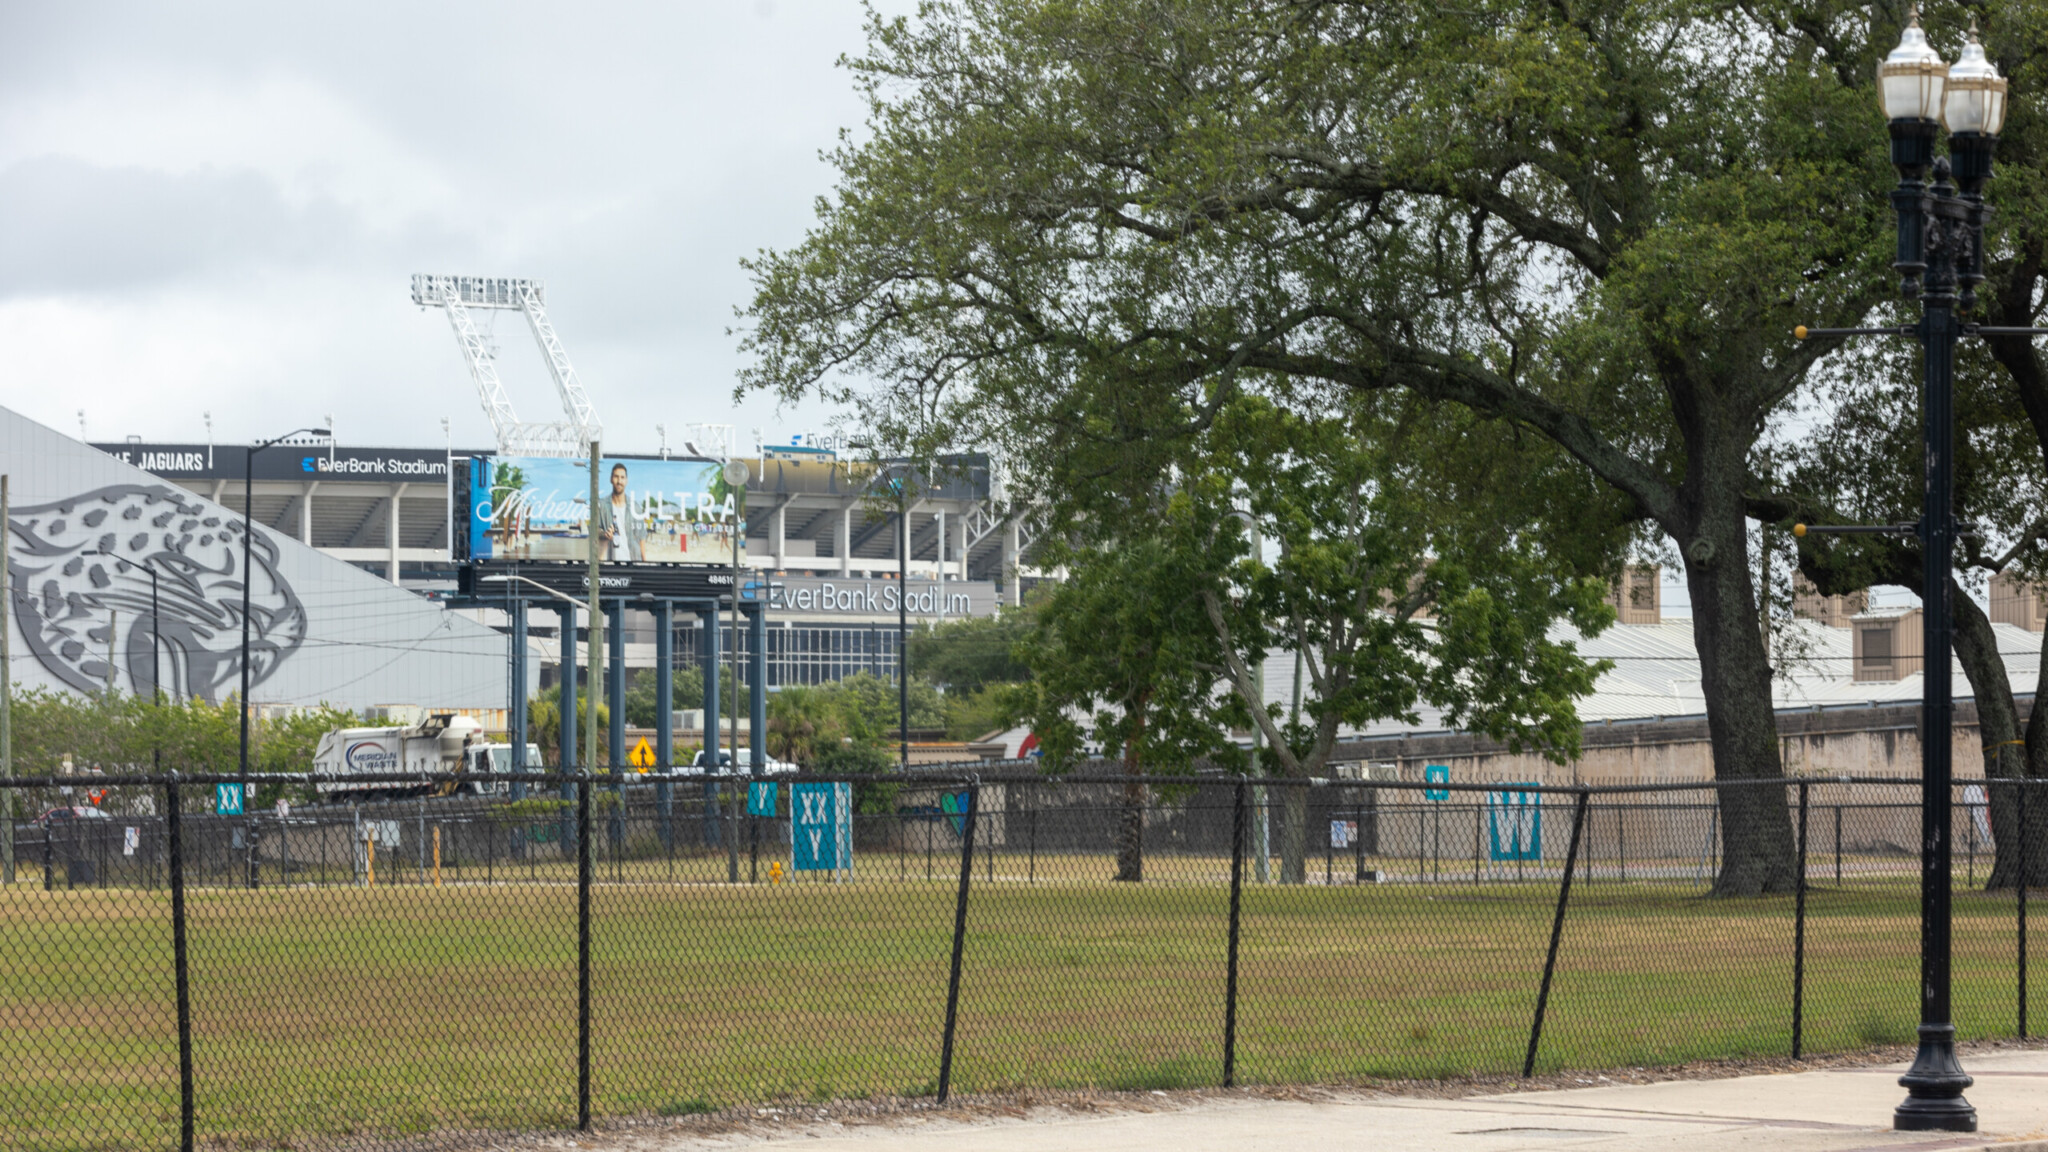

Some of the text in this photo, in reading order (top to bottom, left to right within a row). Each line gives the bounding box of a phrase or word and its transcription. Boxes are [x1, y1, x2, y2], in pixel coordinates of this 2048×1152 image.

[138, 452, 203, 471] JAGUARS
[318, 457, 446, 475] EverBank Stadium
[630, 490, 742, 523] ULTRA
[770, 582, 878, 611] EverBank
[354, 752, 397, 762] MERIDIAN
[365, 760, 397, 769] WASTE
[219, 785, 240, 810] XX
[800, 792, 828, 825] XX
[1491, 787, 1538, 853] W
[808, 828, 822, 861] Y
